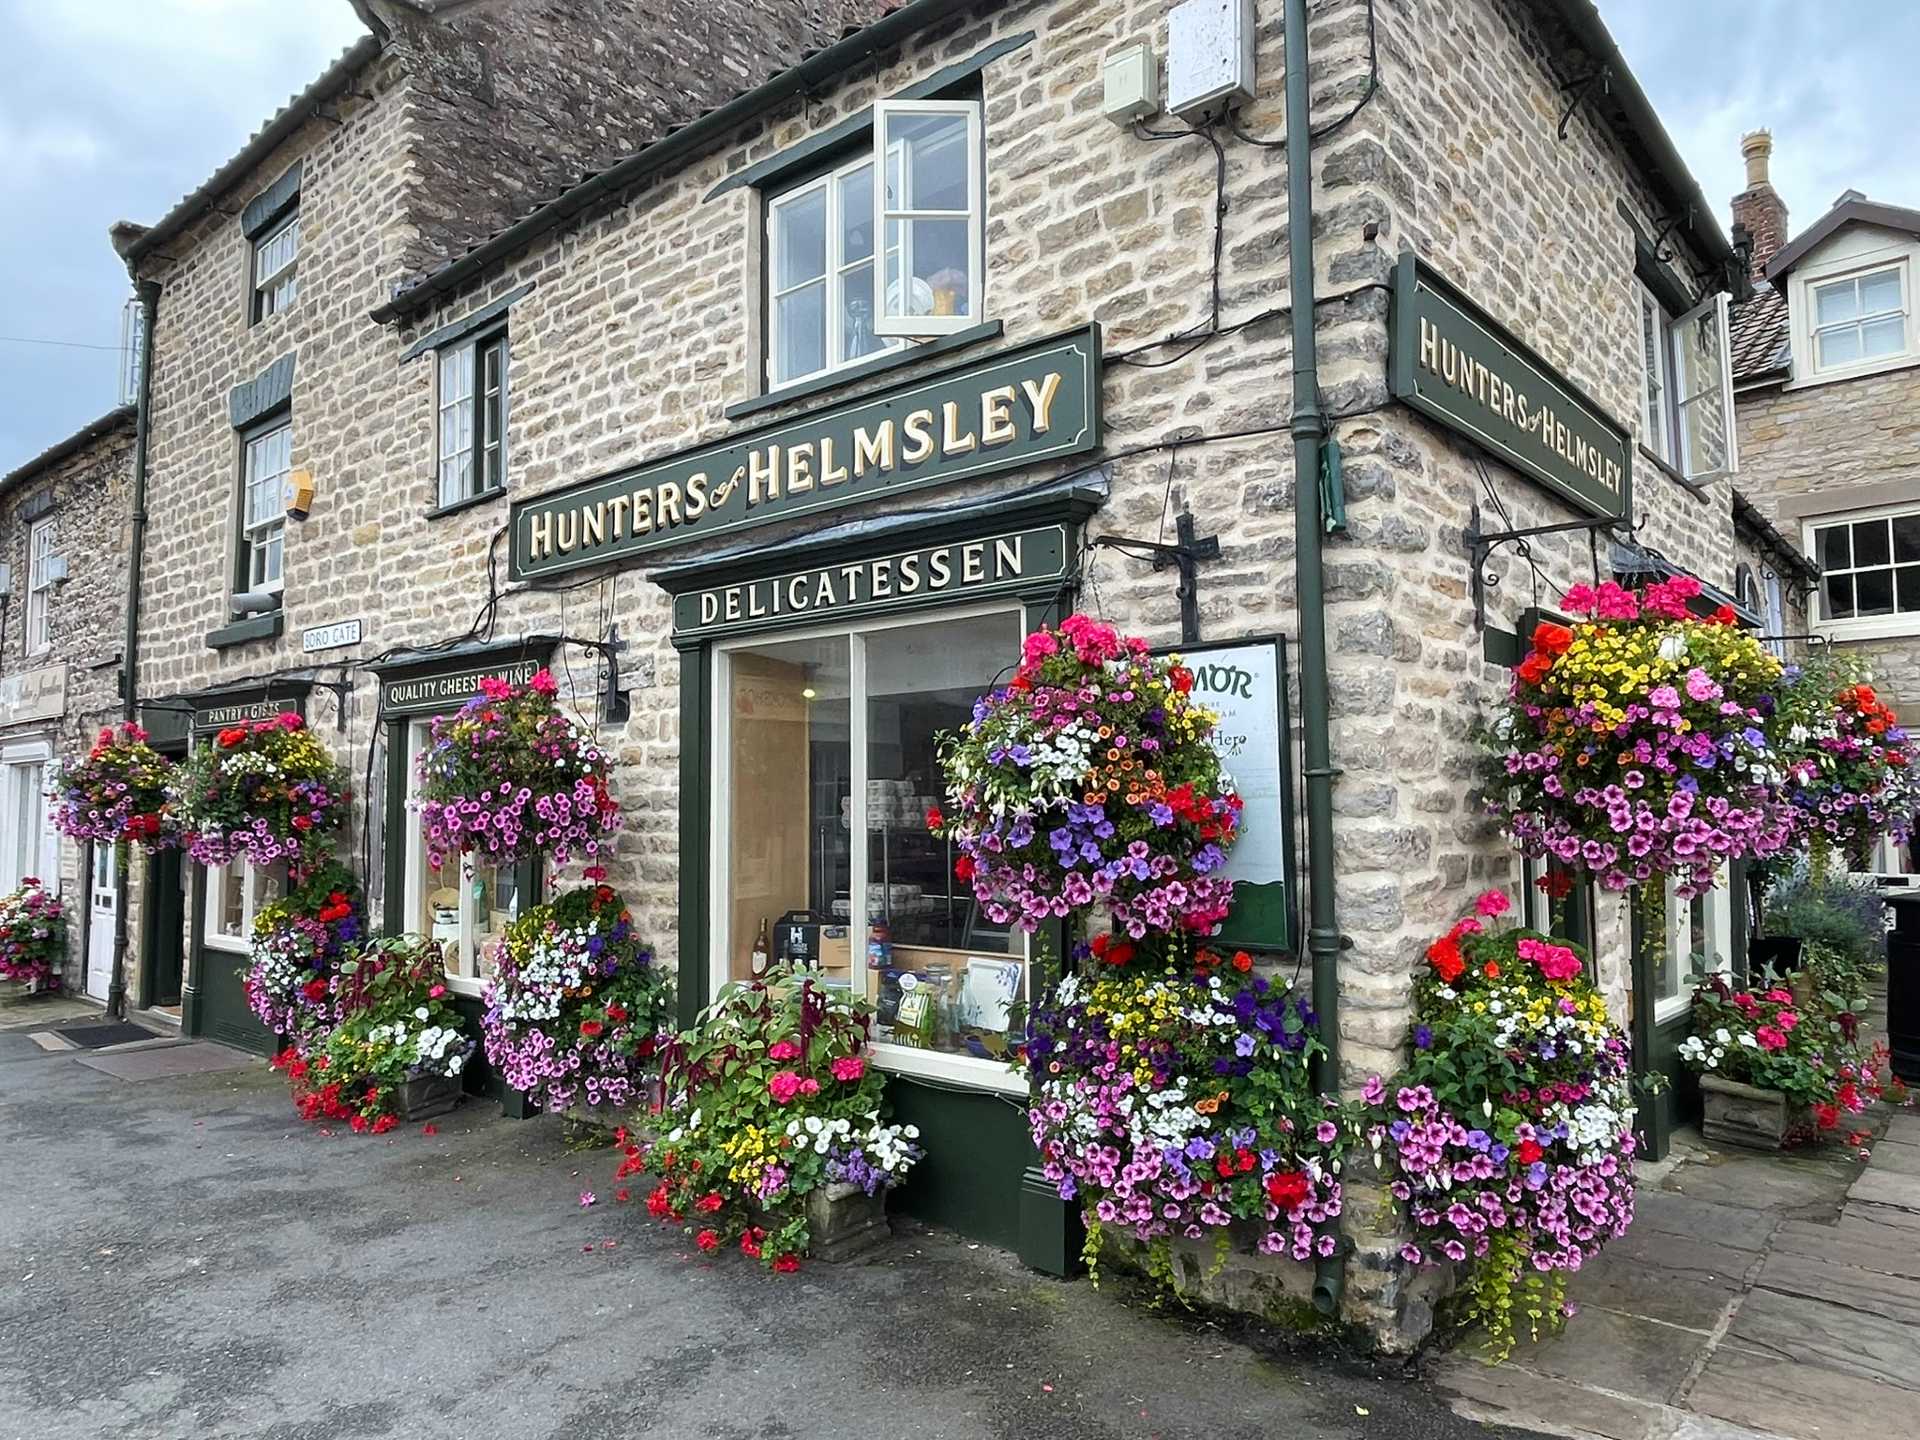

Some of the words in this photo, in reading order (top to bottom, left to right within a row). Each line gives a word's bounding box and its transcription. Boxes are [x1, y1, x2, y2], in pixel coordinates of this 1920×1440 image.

[1420, 316, 1528, 432] HUNTERS
[1541, 405, 1622, 496] HELMSLEY
[530, 472, 708, 560] HUNTERS
[748, 372, 1061, 503] HELMSLEY
[701, 536, 1023, 624] DELICATESSEN
[305, 630, 329, 649] BORO
[333, 624, 357, 643] GATE
[208, 707, 242, 723] PANTRY
[390, 681, 437, 703] QUALITY
[498, 667, 532, 686] WINE
